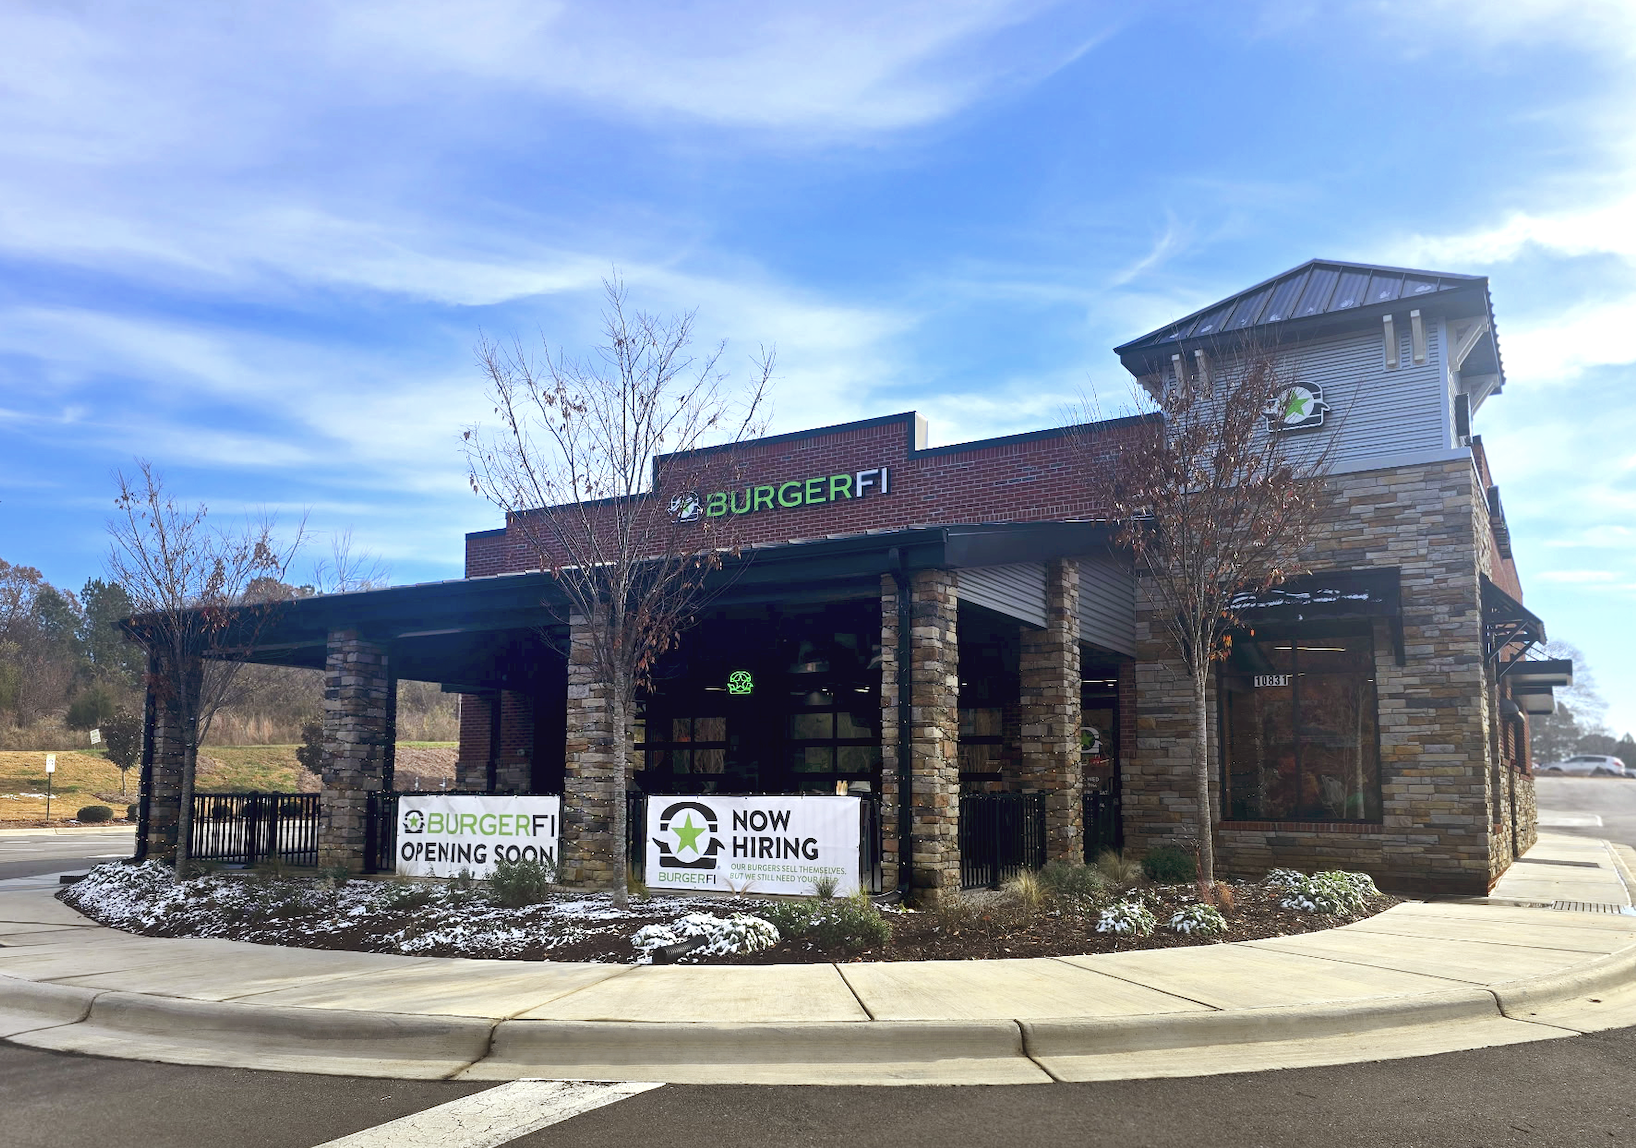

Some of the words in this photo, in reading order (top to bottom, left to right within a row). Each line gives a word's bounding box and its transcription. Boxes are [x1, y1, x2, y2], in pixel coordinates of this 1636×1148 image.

[706, 467, 889, 518] BURGERFI
[1255, 675, 1288, 687] 10831
[427, 812, 555, 837] BURGERFI
[732, 809, 791, 832] NOW
[401, 841, 487, 864] OPENING
[494, 844, 554, 868] SOON
[732, 836, 819, 860] HIRING
[658, 871, 716, 885] BURGERFI
[731, 863, 746, 871] OUR
[747, 863, 781, 872] BURGERS
[781, 865, 797, 873] SELL
[744, 873, 756, 881] WE
[757, 873, 775, 881] STILL
[797, 875, 817, 883] YOUR
